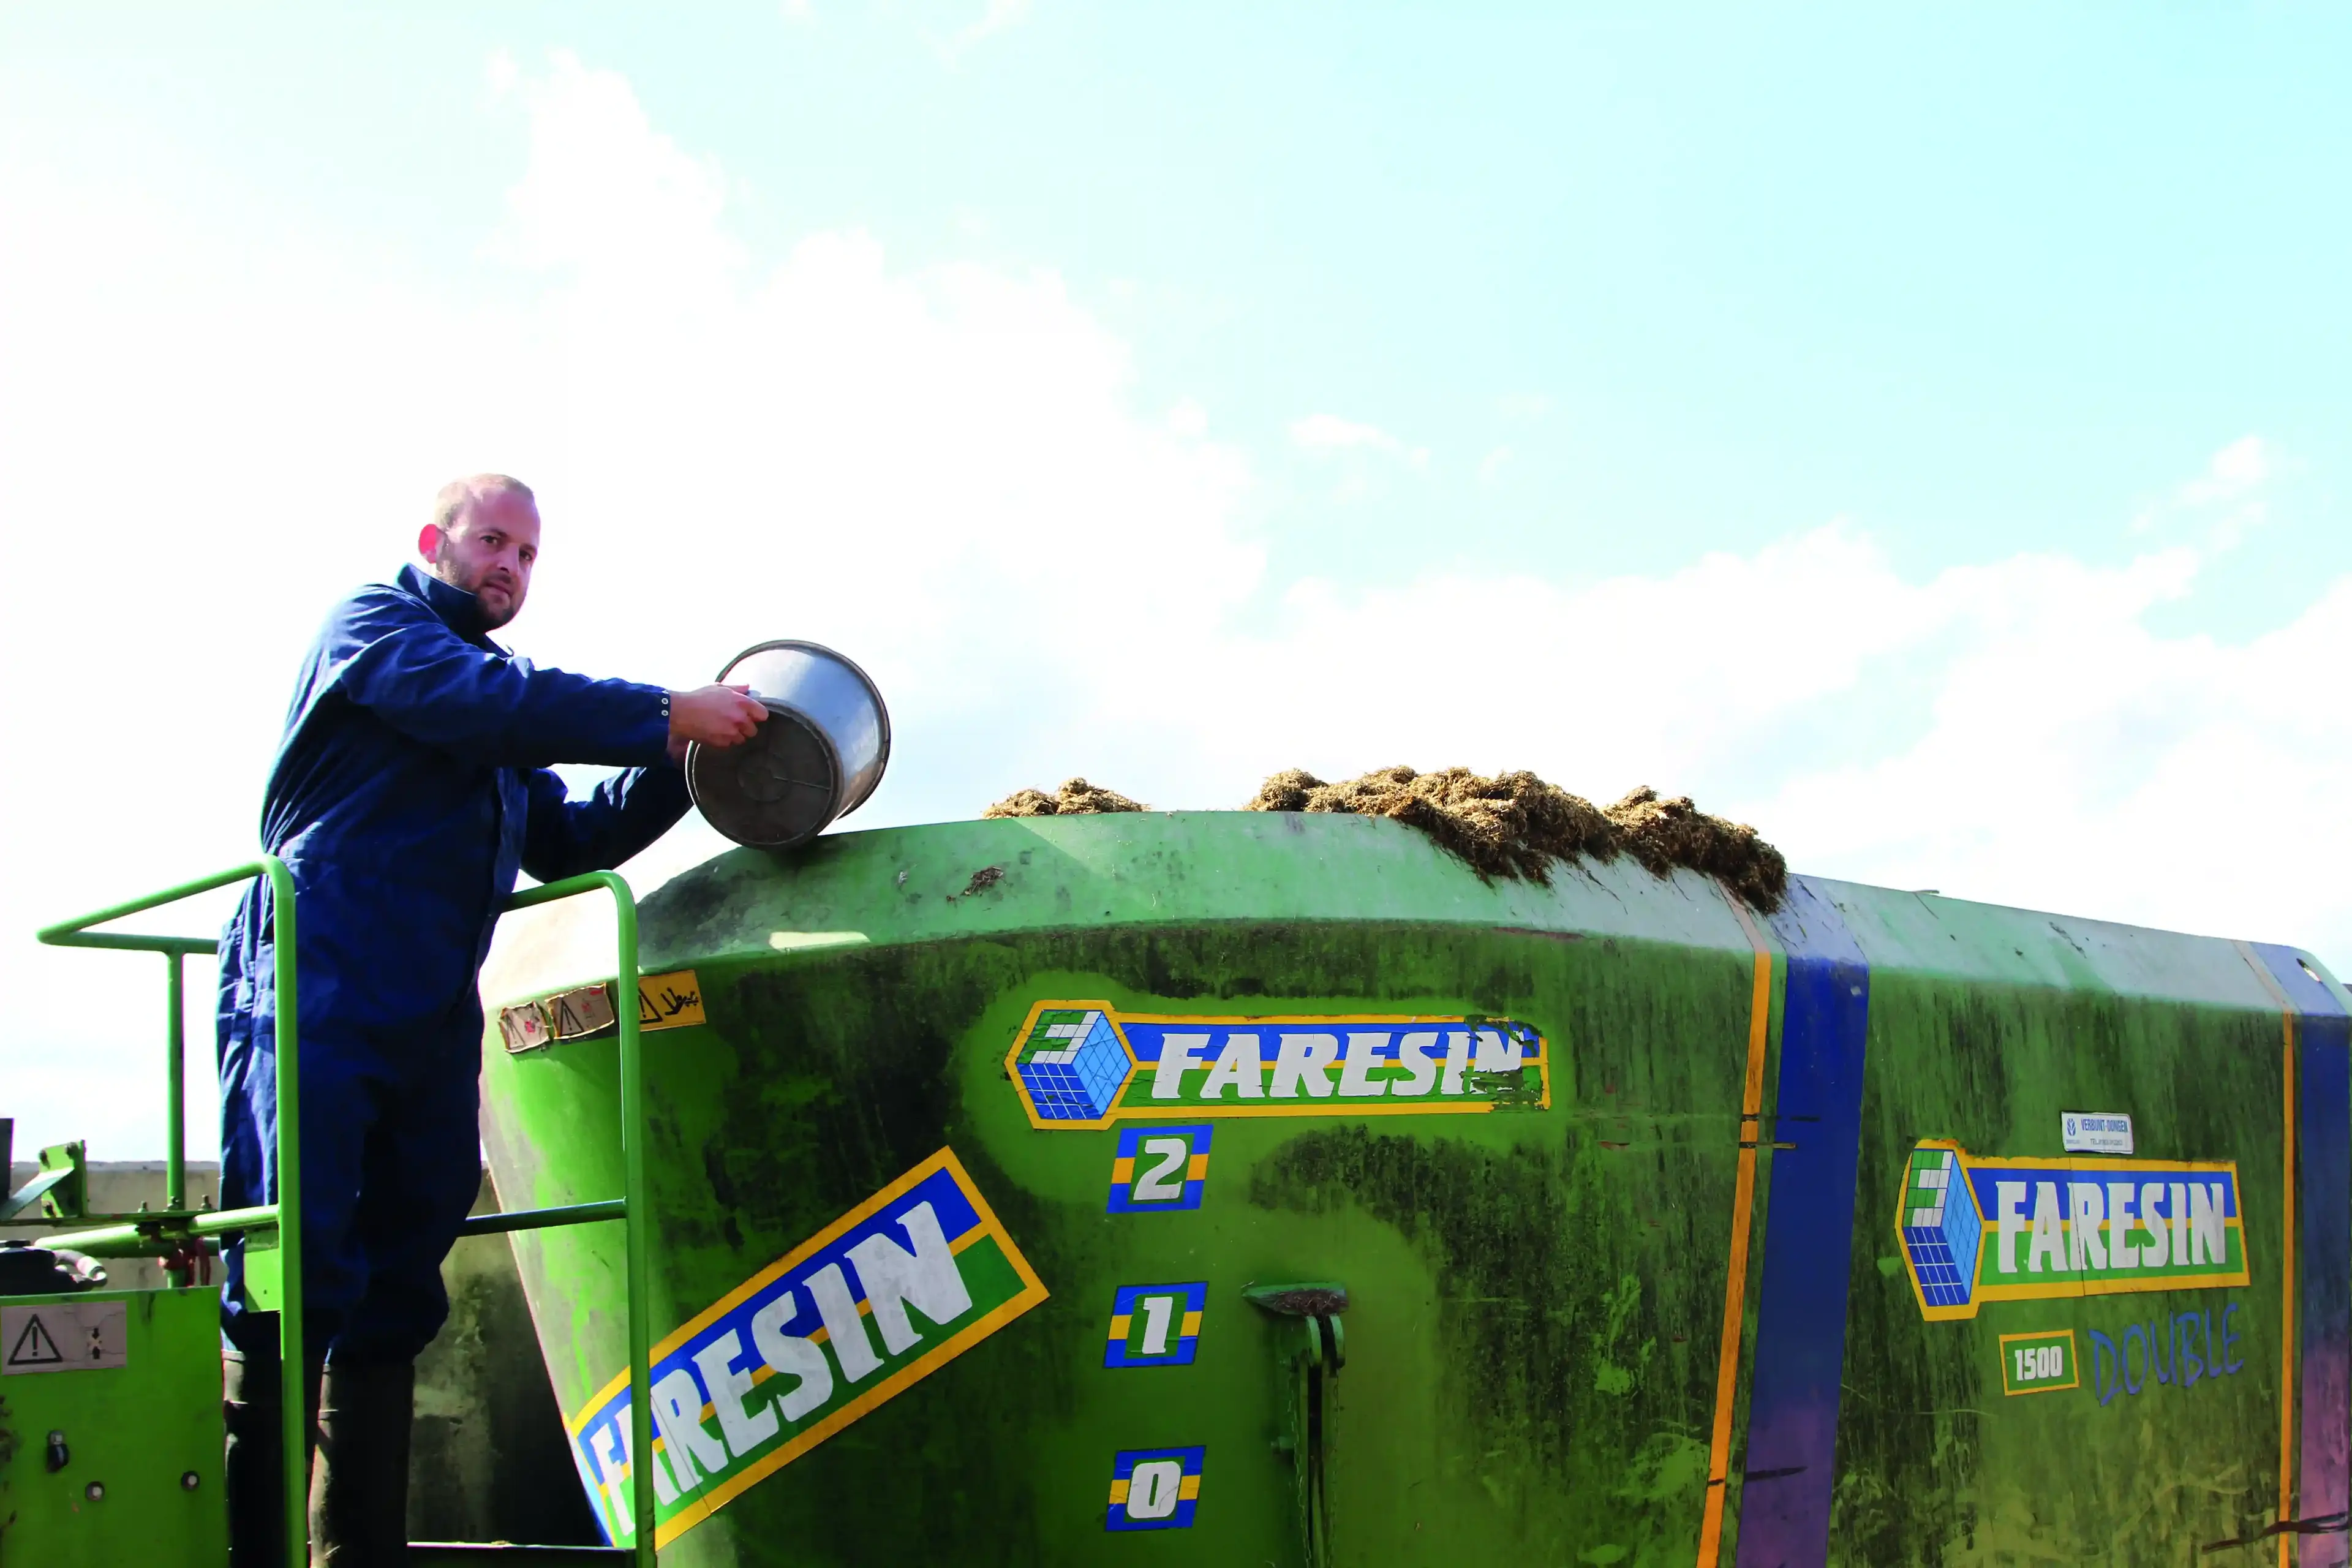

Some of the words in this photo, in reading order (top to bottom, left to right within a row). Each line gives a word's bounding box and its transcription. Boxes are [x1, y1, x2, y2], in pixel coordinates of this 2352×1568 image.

[1152, 1032, 1524, 1098] FARESIN
[1133, 1139, 1187, 1201] 2
[1996, 1181, 2226, 1273] FARESIN
[1142, 1296, 1174, 1354] 1
[2088, 1303, 2244, 1407] DOUBLE
[2015, 1346, 2062, 1381] 1500
[1127, 1461, 1182, 1518] 0
